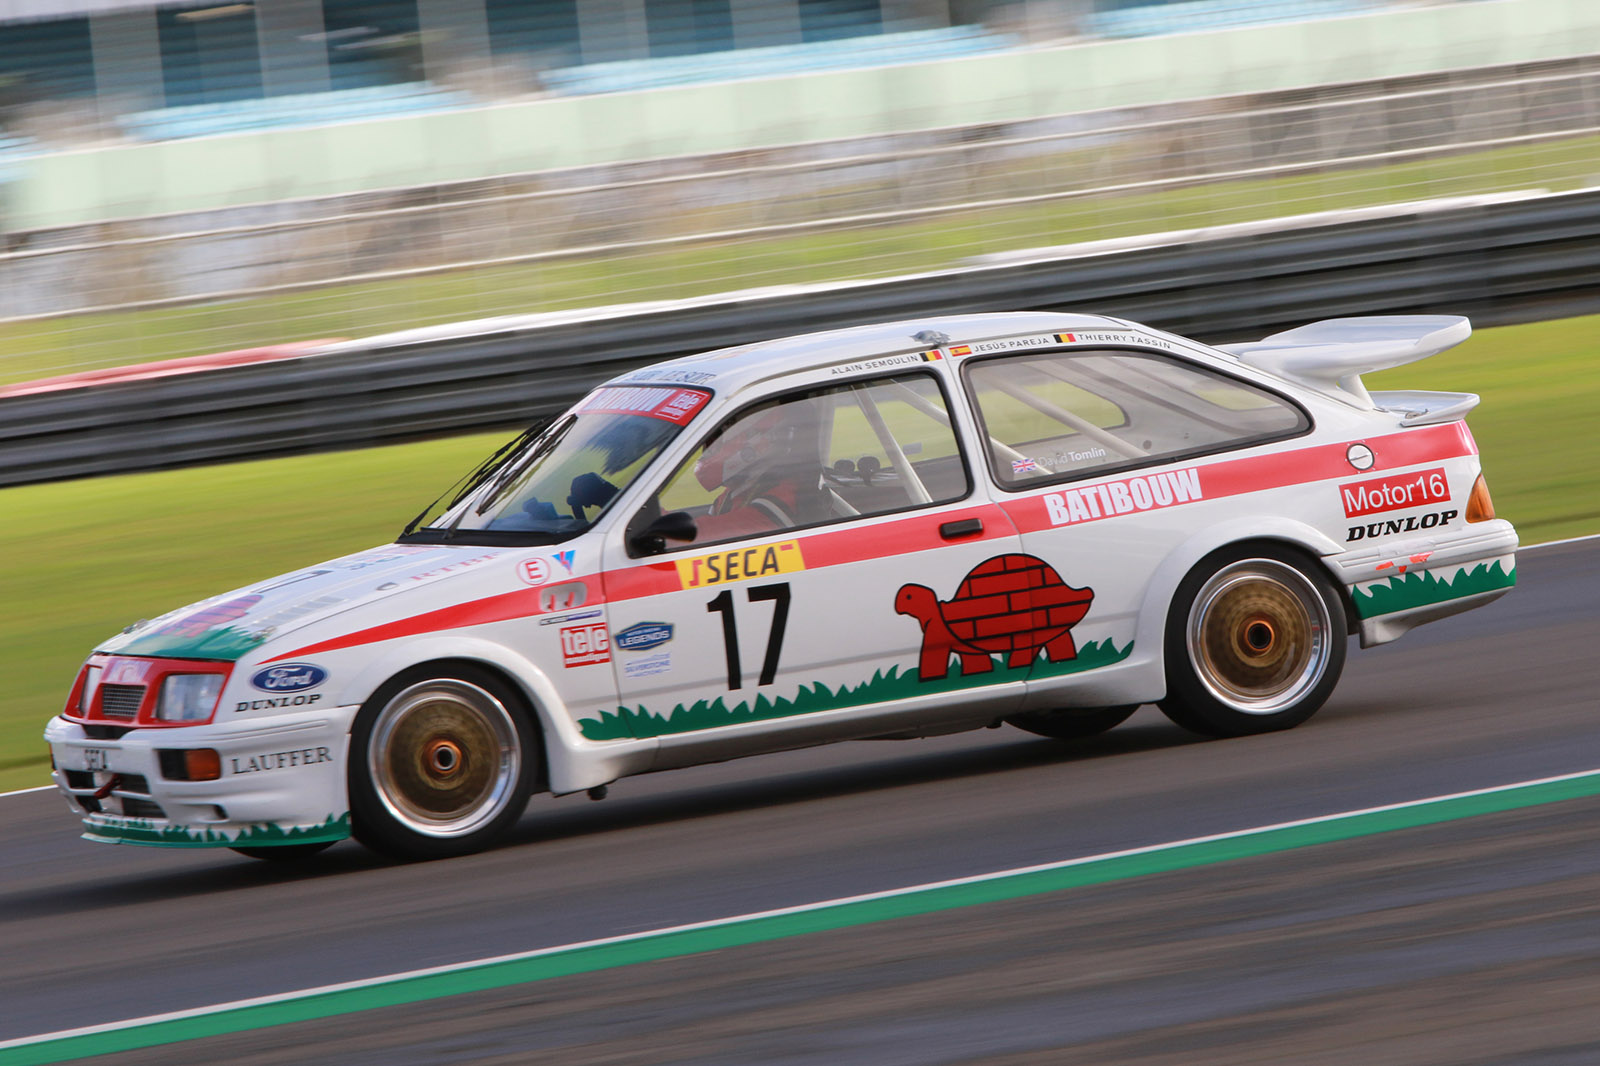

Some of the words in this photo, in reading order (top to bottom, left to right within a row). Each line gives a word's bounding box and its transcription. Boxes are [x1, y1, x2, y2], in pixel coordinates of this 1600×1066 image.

[1009, 337, 1050, 348] PAREJA
[1078, 333, 1127, 343] THIERRY
[1129, 335, 1171, 350] TASSIN
[832, 364, 863, 375] ALAIN
[865, 355, 918, 369] SEMOULIN
[1067, 447, 1107, 462] Tomlin
[1043, 467, 1203, 527] BATIBOUW
[1343, 473, 1445, 513] Motor16
[1345, 509, 1459, 543] DUNLOP
[706, 546, 780, 585] SECA
[619, 629, 670, 647] LEGENDS
[706, 581, 792, 691] 17
[264, 667, 315, 689] Ford
[234, 693, 322, 713] DUNLOP
[231, 746, 333, 775] LAUFFER
